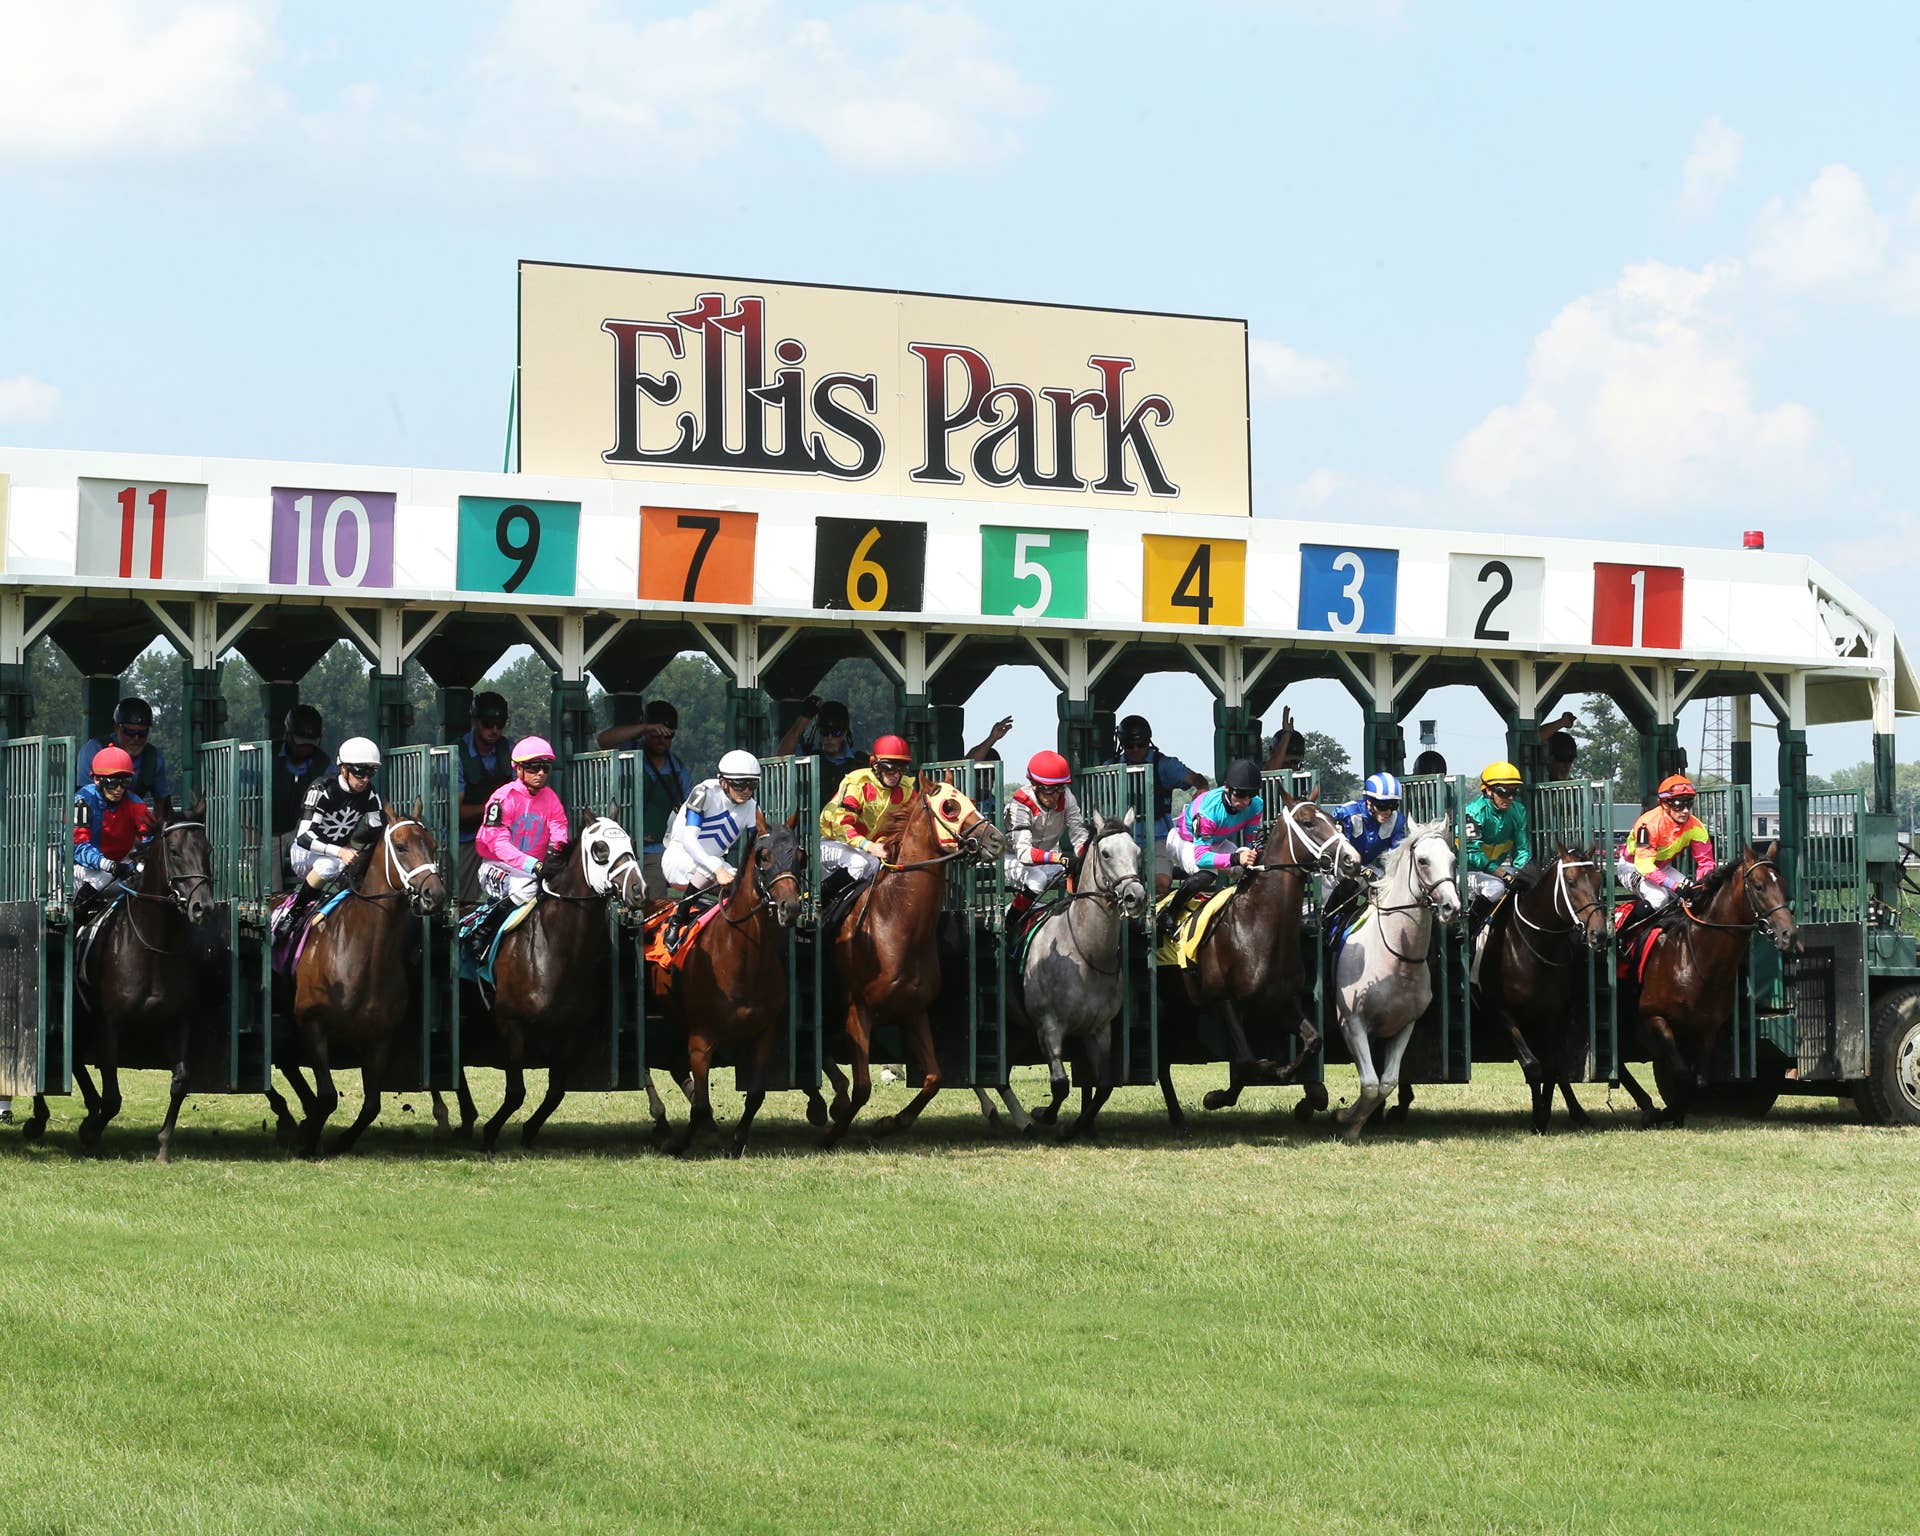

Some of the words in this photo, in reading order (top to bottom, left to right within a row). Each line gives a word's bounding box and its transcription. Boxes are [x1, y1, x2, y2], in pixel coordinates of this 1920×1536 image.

[601, 293, 884, 482] Ellis
[908, 342, 1180, 498] Park
[117, 487, 167, 579] 11
[293, 495, 371, 588] 10
[495, 504, 541, 594] 9
[677, 515, 722, 602] 7
[845, 526, 889, 611] 6
[1011, 533, 1052, 617] 5
[1170, 543, 1215, 625] 4
[1327, 551, 1365, 634] 3
[1474, 560, 1513, 641] 2
[1631, 570, 1646, 648] 1
[73, 806, 88, 824] 11
[304, 789, 318, 806] 10
[488, 804, 499, 822] 9
[692, 790, 705, 806] 7
[1466, 823, 1477, 837] 2
